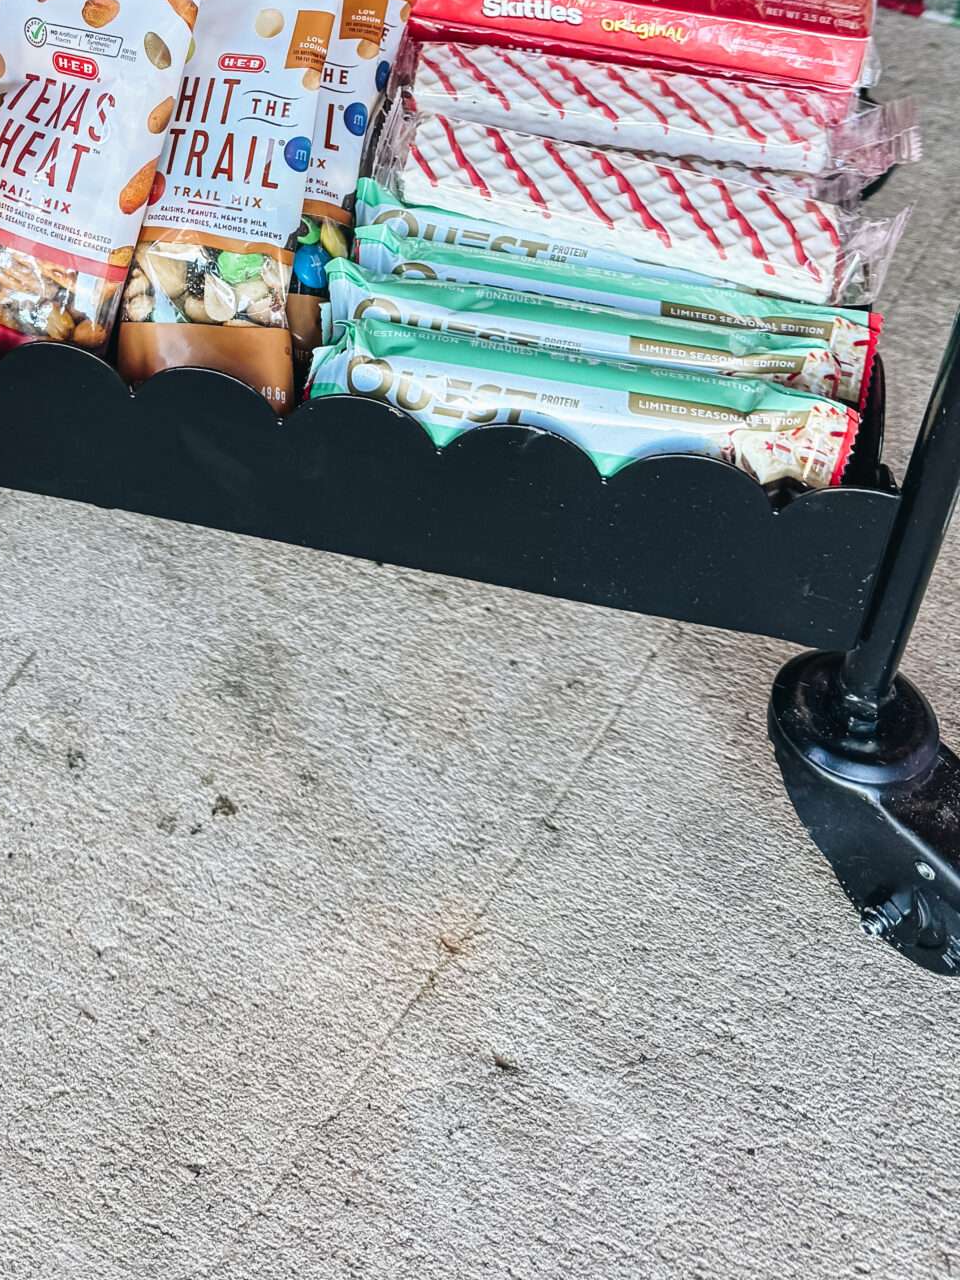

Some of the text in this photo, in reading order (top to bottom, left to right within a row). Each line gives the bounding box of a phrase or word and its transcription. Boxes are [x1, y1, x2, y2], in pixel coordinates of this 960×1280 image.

[351, 14, 381, 24] SODIUM
[358, 8, 376, 16] LOW
[299, 42, 328, 55] SODIUM
[307, 35, 325, 44] LOW
[7, 73, 116, 143] TEXAS
[174, 76, 292, 124] HIT THE
[166, 128, 279, 190] TRAIL
[41, 195, 72, 214] MIX
[173, 185, 264, 209] TRAIL MIX
[5, 213, 26, 228] SESAME
[14, 206, 35, 221] SALTED
[35, 214, 53, 226] CORN
[83, 231, 112, 245] ROASTED
[147, 214, 283, 241] CHOCOLATE CANDIES, ALMONDS, CASHEWS
[160, 204, 186, 216] RAISINS,
[187, 208, 220, 221] PEANUTS,
[250, 219, 268, 228] MILK
[551, 244, 588, 258] PROTEIN
[669, 307, 825, 336] LIMITED SEASONAL EDITION
[639, 343, 796, 369] LIMITED SEASONAL EDITION
[260, 385, 286, 404] 49.6g
[347, 355, 581, 425] QUEST PROTEIN
[638, 399, 802, 427] LIMITED SEASONAL EDITION
